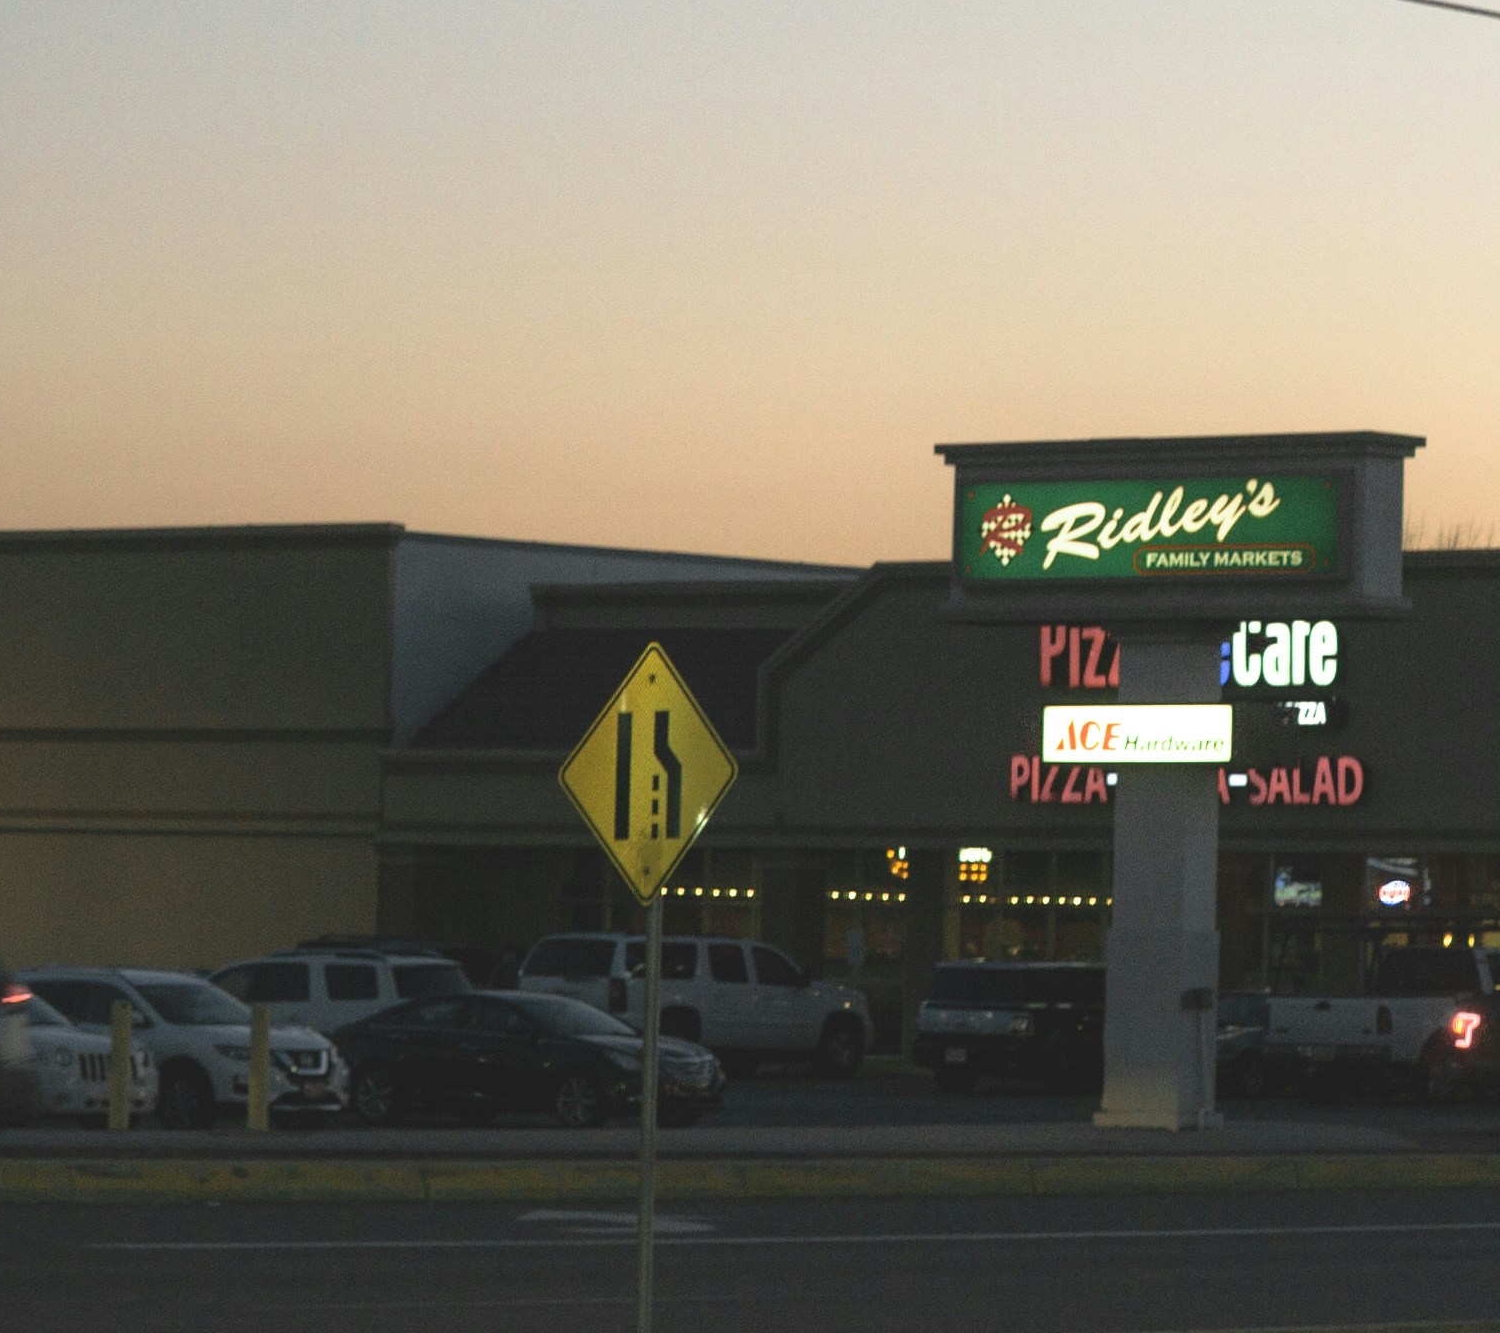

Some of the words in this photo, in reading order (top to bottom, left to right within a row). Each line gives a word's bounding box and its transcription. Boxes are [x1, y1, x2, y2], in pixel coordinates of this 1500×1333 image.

[1040, 478, 1280, 570] Ridley's
[1145, 550, 1210, 568] FAMILY
[1213, 548, 1303, 567] MARKETS
[1056, 720, 1121, 751] ACE
[1124, 735, 1225, 752] Hardware
